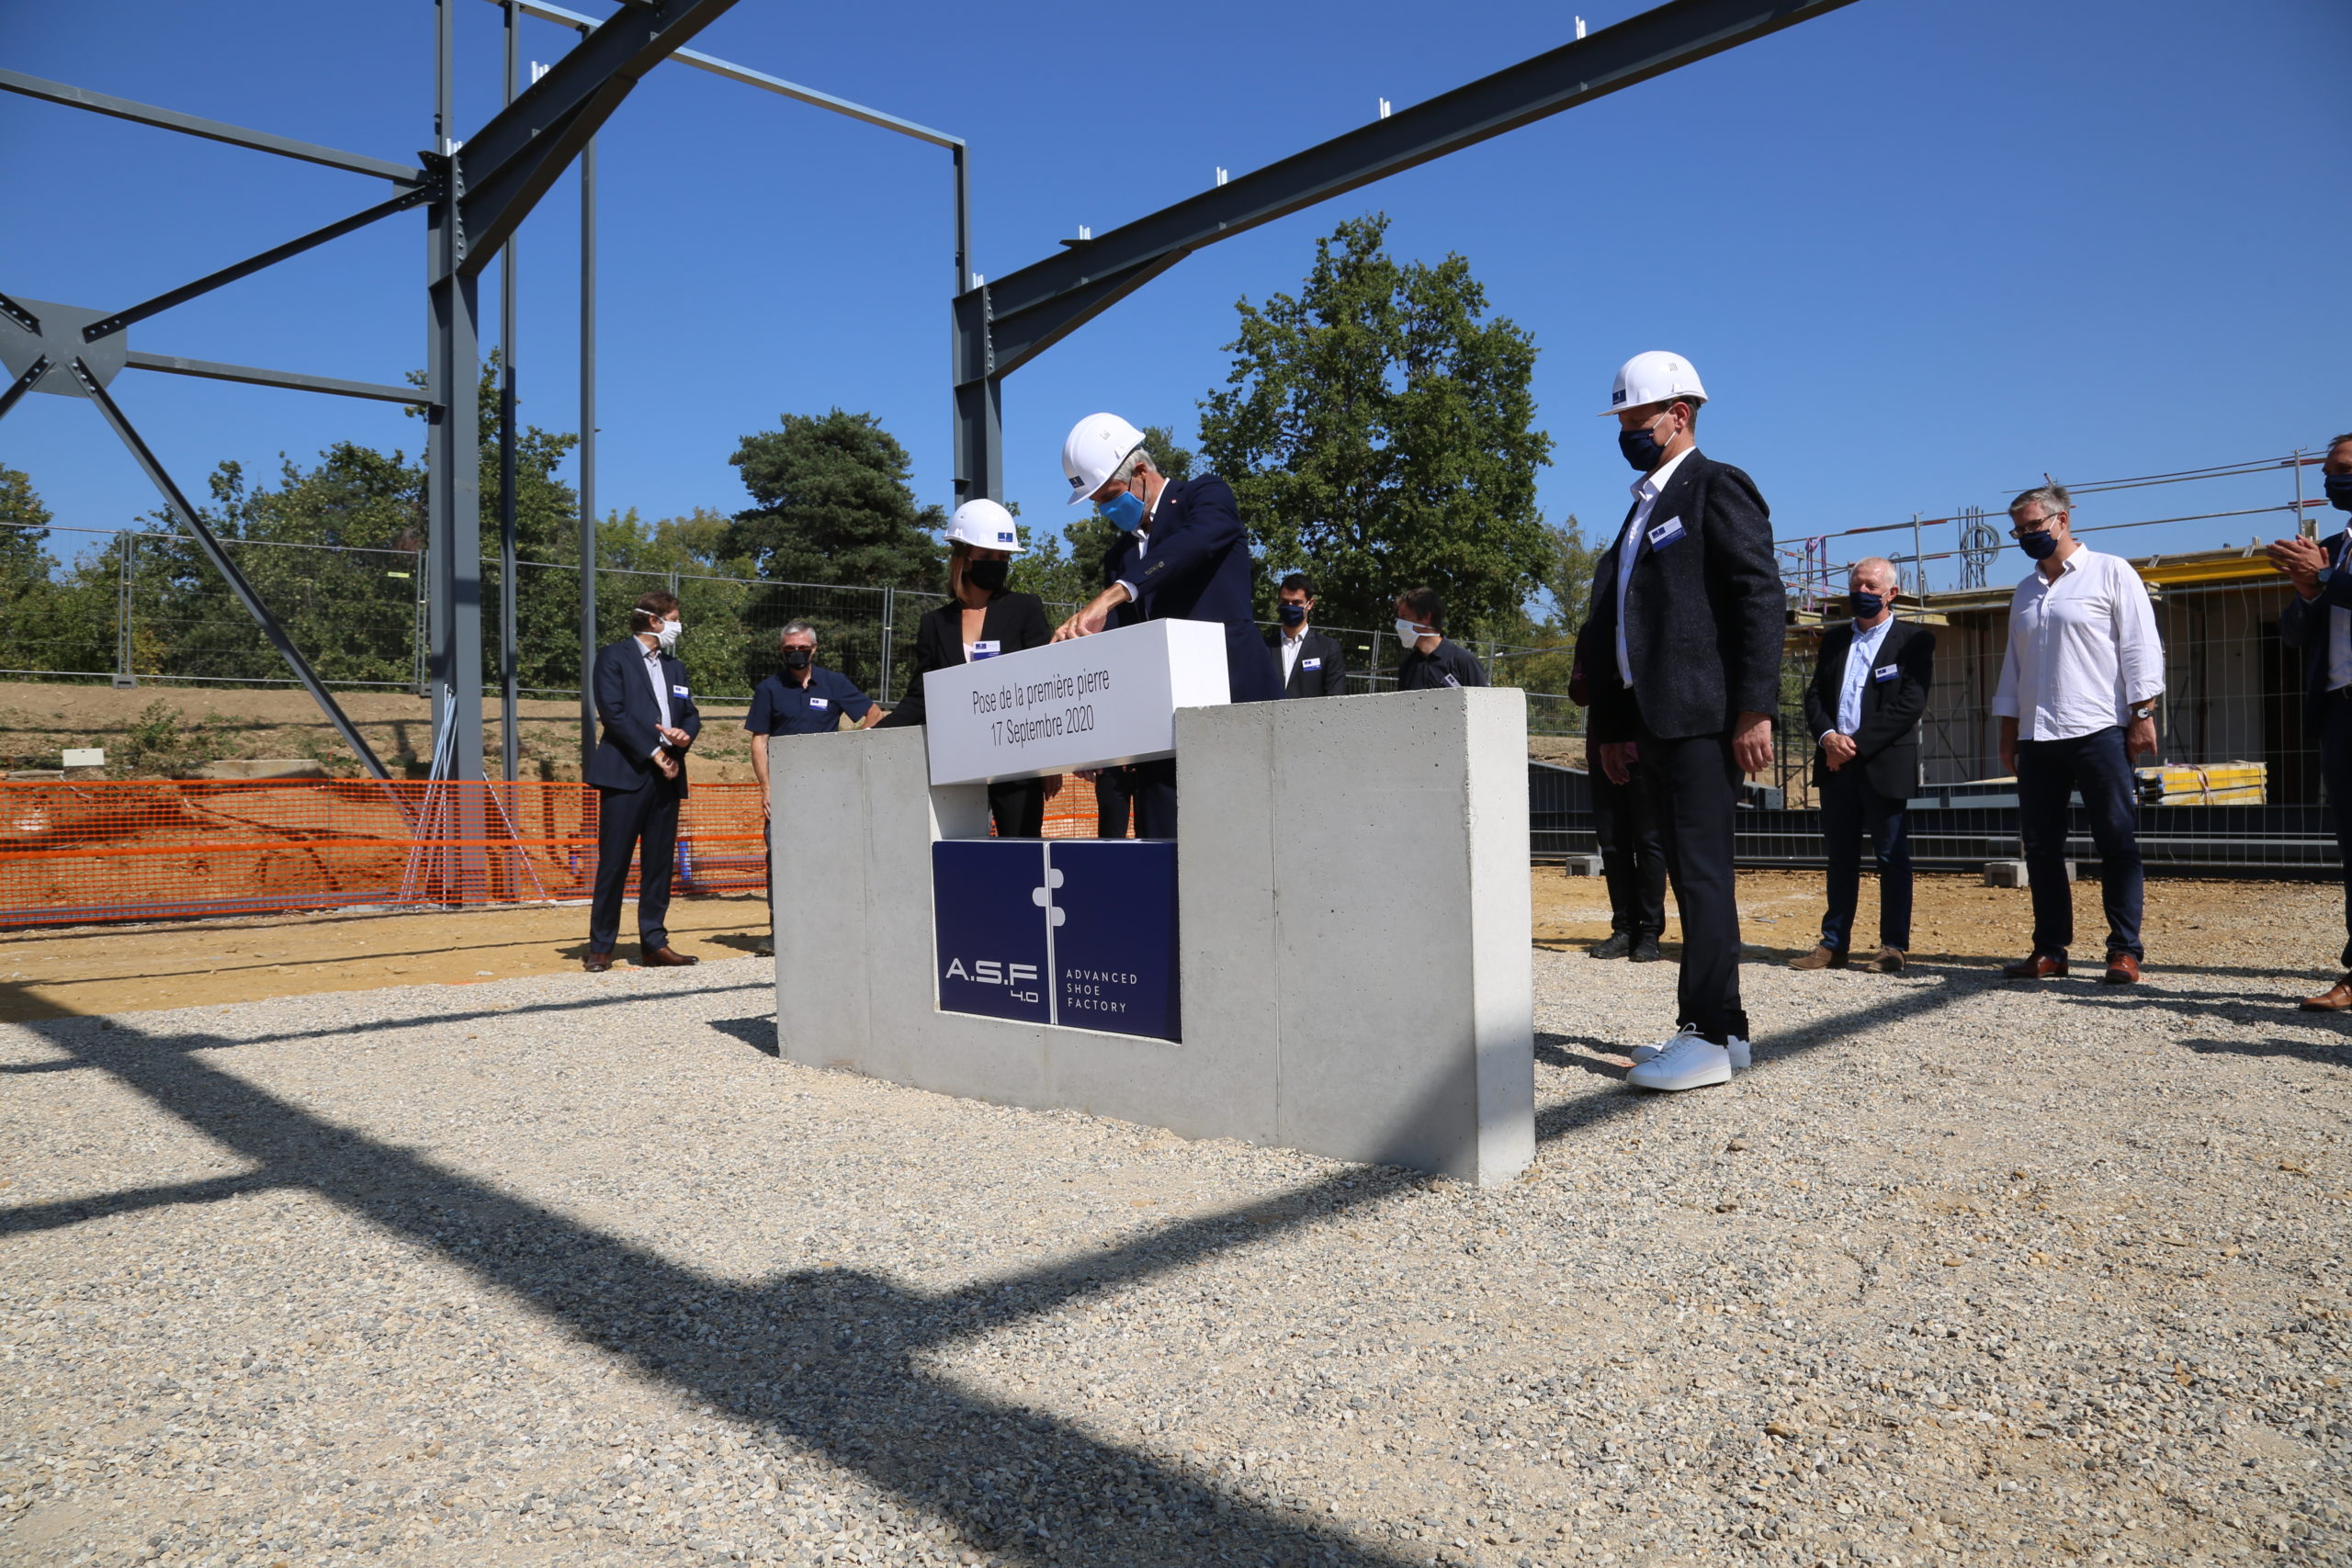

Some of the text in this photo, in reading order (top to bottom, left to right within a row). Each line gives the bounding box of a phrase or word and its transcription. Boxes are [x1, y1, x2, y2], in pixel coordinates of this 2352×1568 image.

[972, 668, 1110, 715] Pose de la première pierre
[991, 705, 1094, 748] 17 Septembre 2020
[945, 957, 1037, 986] A.S.F
[1066, 968, 1137, 985] ADVANCED
[1011, 990, 1039, 1003] 4.0
[1067, 983, 1100, 996] SHOE
[1068, 998, 1126, 1013] FACTORY
